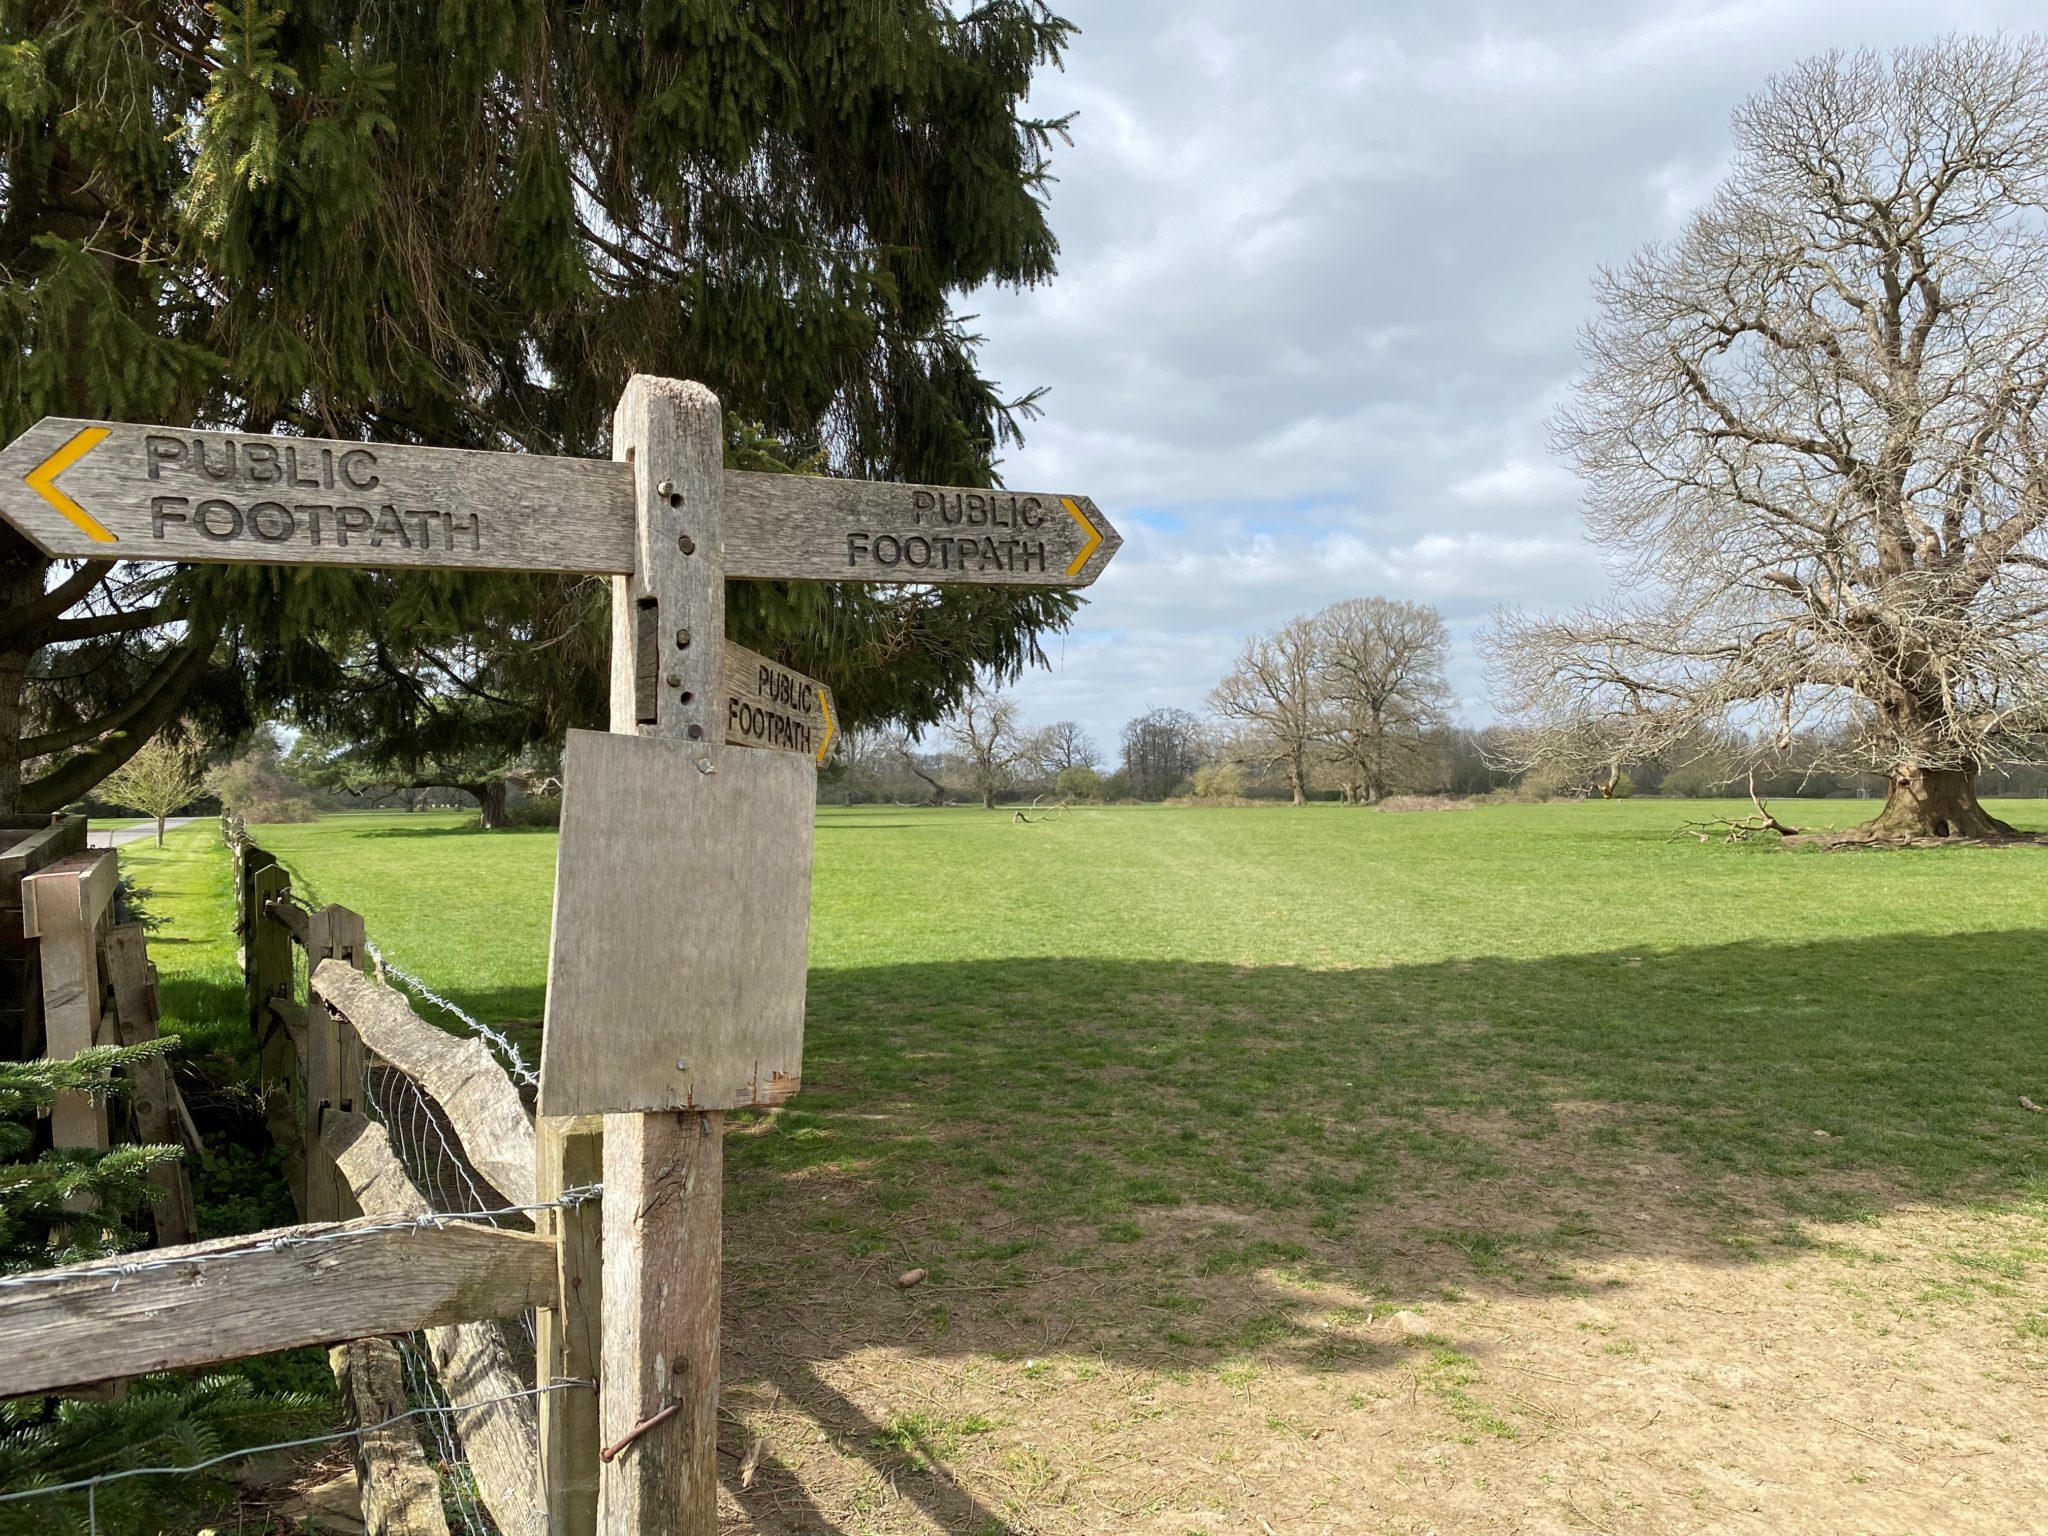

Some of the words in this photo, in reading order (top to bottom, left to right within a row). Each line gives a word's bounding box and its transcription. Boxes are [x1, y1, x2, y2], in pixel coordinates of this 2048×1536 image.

[144, 435, 379, 491] PUBLIC
[151, 496, 481, 551] FOOTPATH
[911, 490, 1045, 530] PUBLIC
[847, 533, 1046, 572] FOOTPATH
[758, 664, 812, 714] PUBLIC
[728, 697, 811, 754] FOOTPATH
